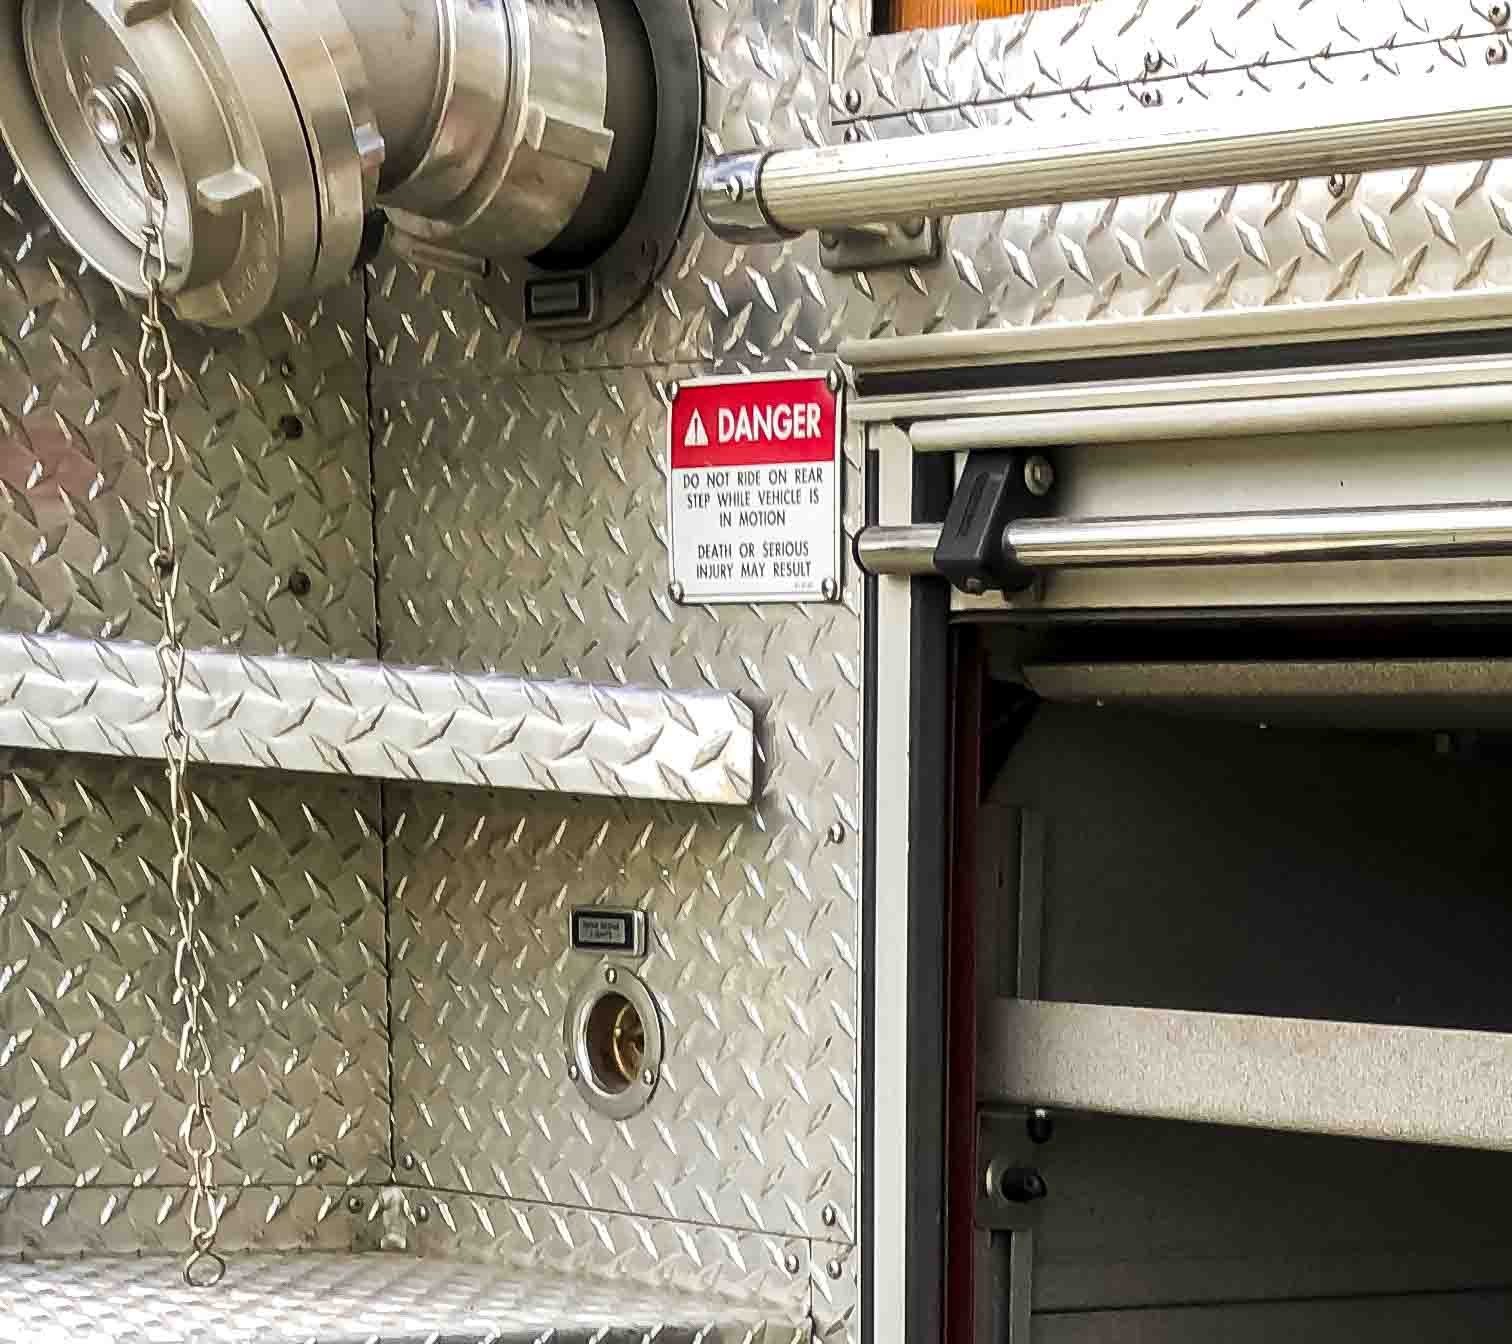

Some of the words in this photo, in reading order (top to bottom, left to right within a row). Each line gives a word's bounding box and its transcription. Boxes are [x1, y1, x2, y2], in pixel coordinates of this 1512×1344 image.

[718, 402, 821, 443] DANGER
[683, 472, 699, 488] DO
[706, 472, 728, 488] NOT
[737, 470, 761, 486] RIDE
[768, 468, 787, 485] ON
[795, 467, 823, 484] REAR
[687, 492, 709, 509] STEP
[717, 490, 750, 507] WHILE
[759, 488, 801, 505] VEHICLE
[809, 487, 819, 504] IS
[719, 511, 731, 528] IN
[739, 509, 785, 527] MOTION
[698, 543, 731, 559] DEATH
[739, 541, 755, 558] OR
[763, 540, 809, 557] SERIOUS
[696, 562, 733, 579] INJURY
[741, 562, 765, 577] MAY
[774, 560, 812, 577] RESULT
